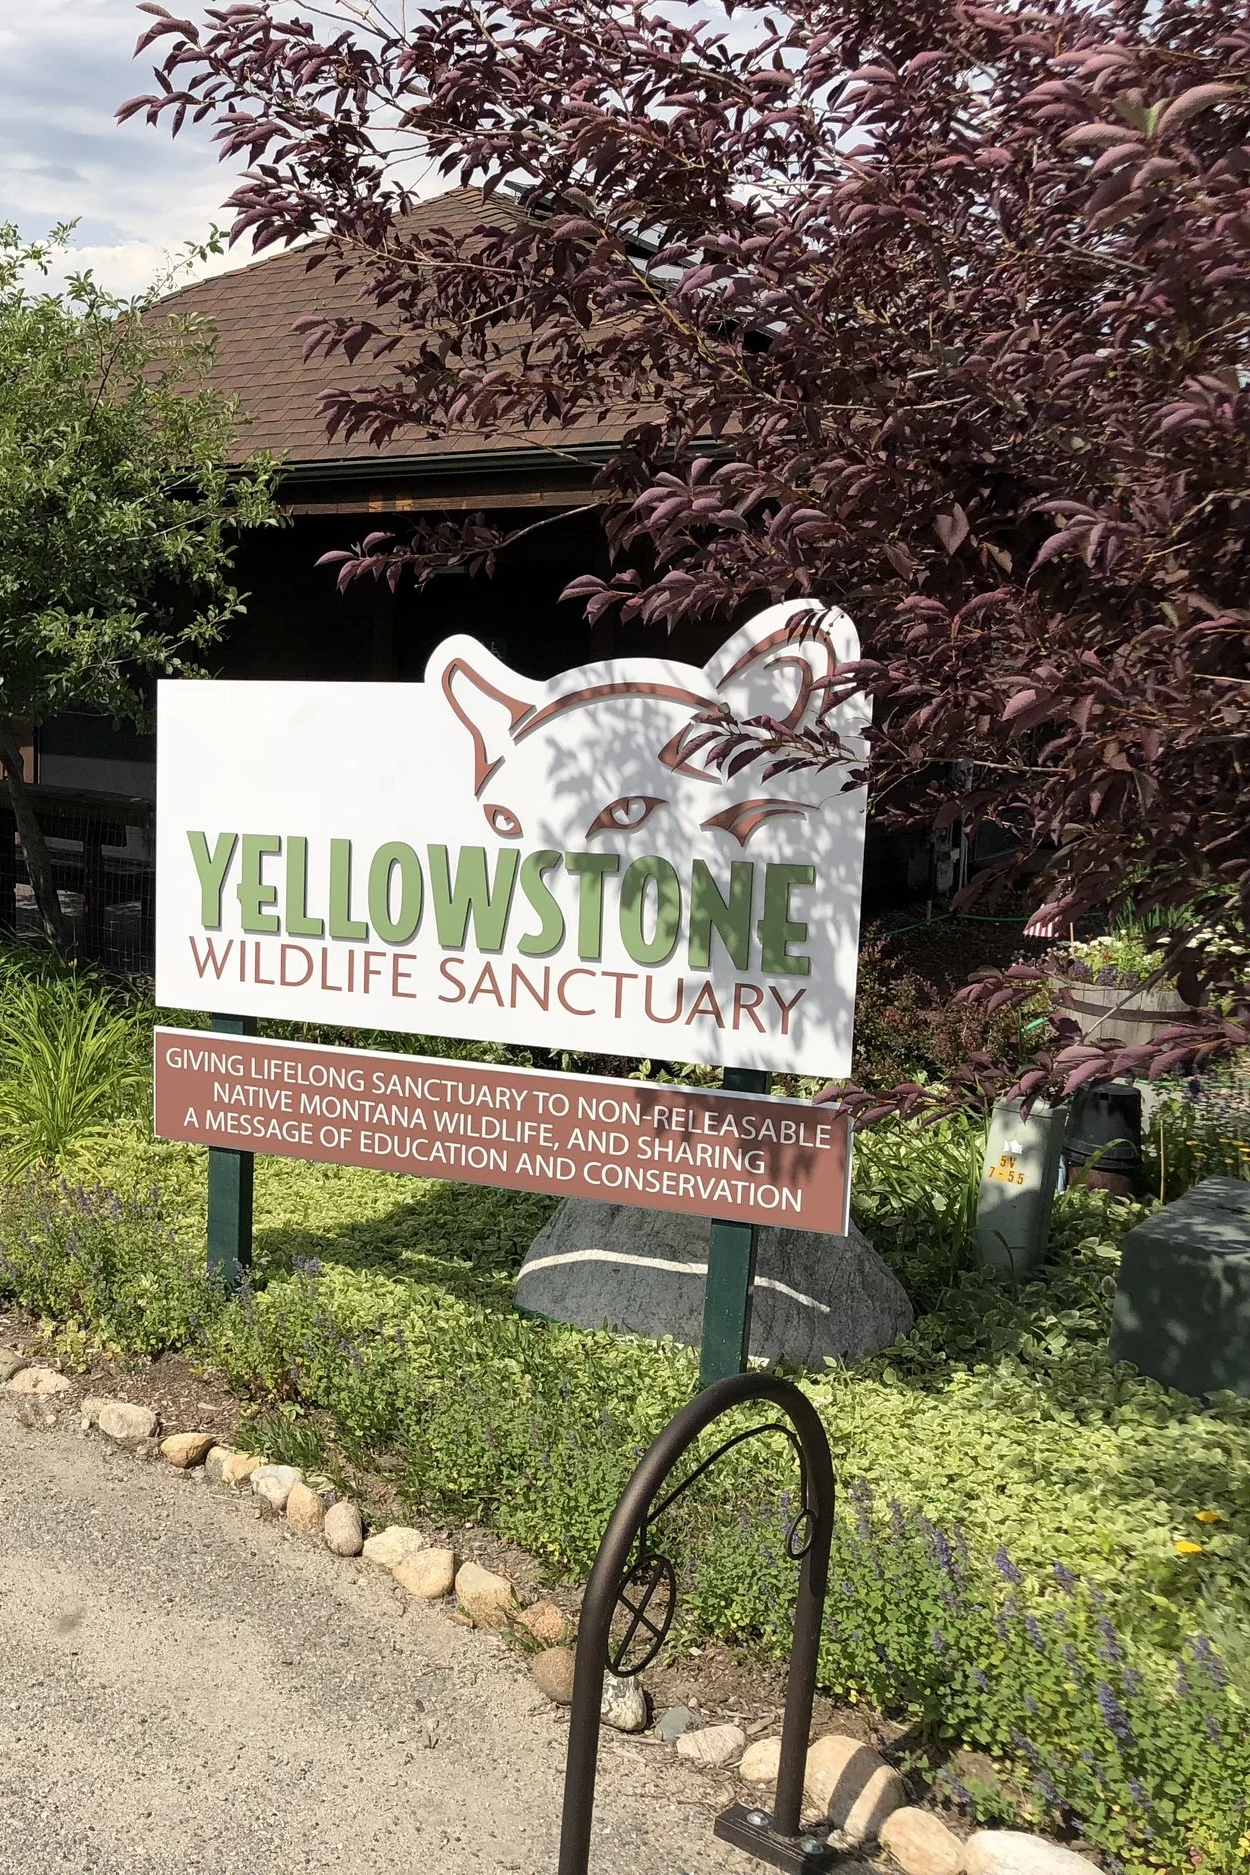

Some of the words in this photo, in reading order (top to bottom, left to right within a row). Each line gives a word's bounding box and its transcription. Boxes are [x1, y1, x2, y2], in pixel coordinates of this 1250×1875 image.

[186, 830, 817, 976] YELLOWSTONE
[188, 935, 417, 999] WILDLIFE
[437, 957, 808, 1035] SANCTUARY
[166, 1047, 244, 1077] GIVING
[250, 1057, 365, 1092] LIFELONG
[372, 1072, 527, 1111] SANCTUARY
[532, 1090, 570, 1117] TO
[577, 1096, 832, 1150] NON-RELEASABLE
[213, 1081, 293, 1113] NATIVE
[299, 1093, 428, 1131] MONTANA
[433, 1110, 561, 1151] WILDLIFE,
[566, 1128, 630, 1157] AND
[636, 1136, 766, 1175] SHARING
[183, 1107, 200, 1129] A
[205, 1109, 313, 1145] MESSAGE
[319, 1125, 353, 1150] OF
[359, 1131, 508, 1173] EDUCATION
[515, 1152, 577, 1181] AND
[582, 1161, 803, 1213] CONSERVATION
